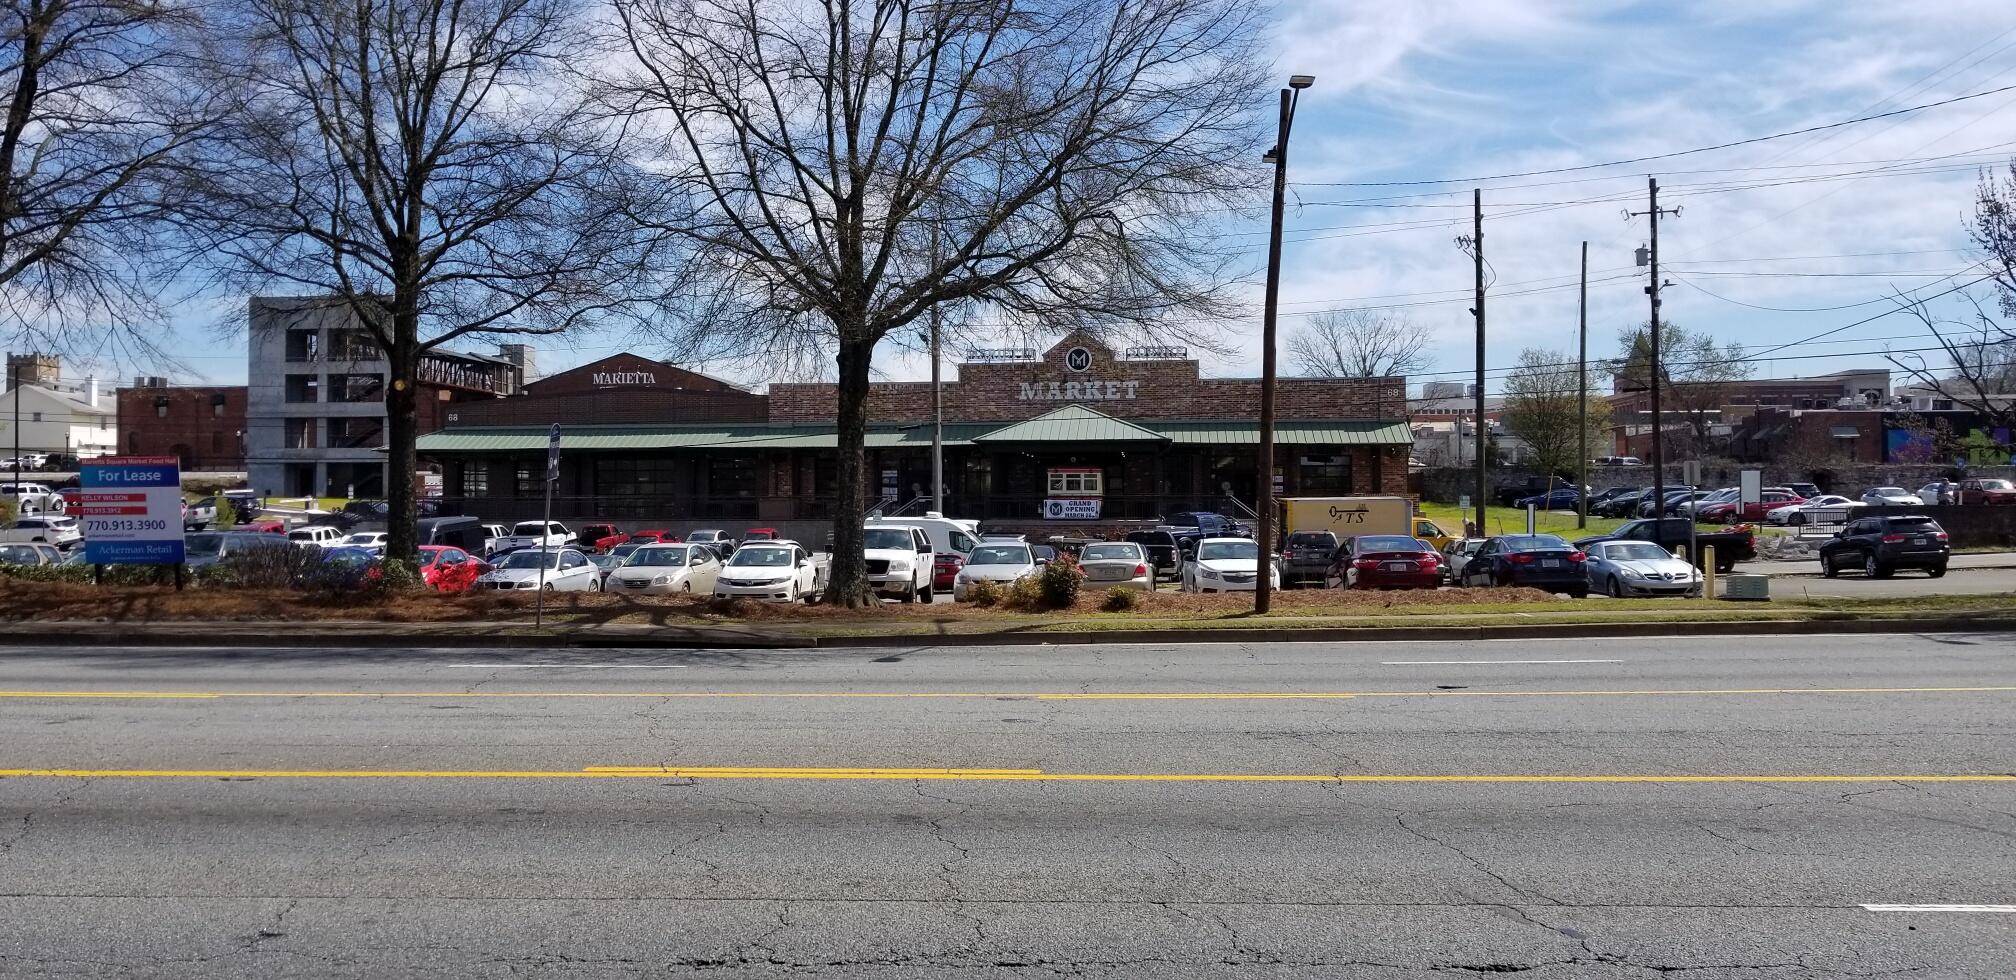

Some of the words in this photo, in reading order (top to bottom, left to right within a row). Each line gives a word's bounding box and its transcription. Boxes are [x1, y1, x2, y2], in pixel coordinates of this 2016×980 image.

[593, 372, 656, 385] MARIETTA
[1019, 380, 1139, 400] MARKET
[1387, 388, 1399, 397] 68
[448, 413, 458, 421] 68
[98, 470, 120, 481] For
[123, 469, 161, 481] Lease
[87, 519, 166, 531] 770.913.3900
[99, 545, 145, 554] Ackerman
[146, 545, 173, 554] Retail
